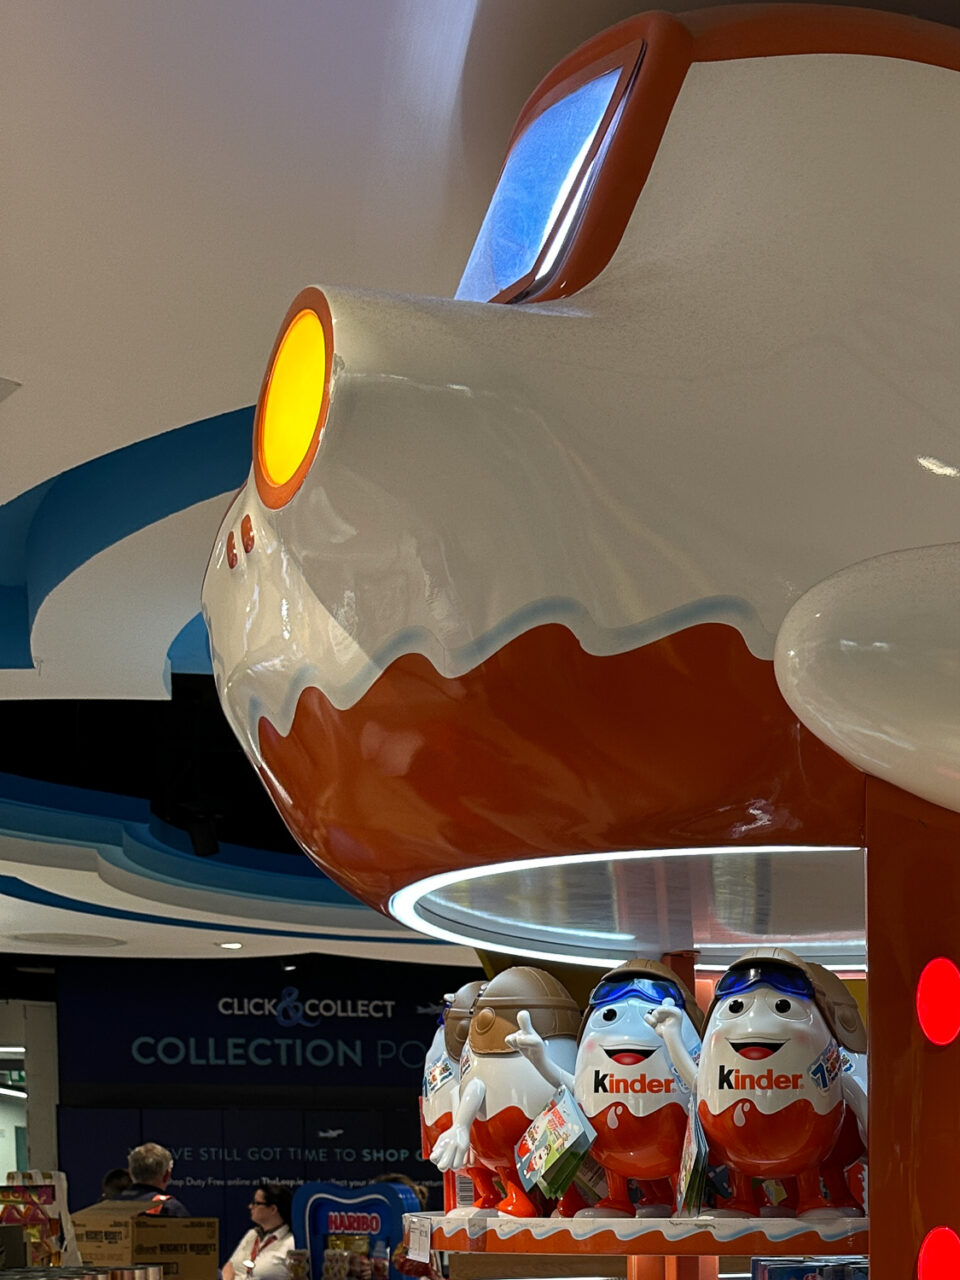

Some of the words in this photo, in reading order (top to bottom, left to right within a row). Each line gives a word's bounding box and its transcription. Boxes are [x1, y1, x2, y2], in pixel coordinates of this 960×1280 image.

[131, 1036, 362, 1067] COLLECTION
[200, 1148, 242, 1161] STILL
[247, 1148, 282, 1161] GOT
[289, 1148, 328, 1162] TIME
[335, 1149, 356, 1162] TO
[361, 1149, 408, 1162] SHOP
[185, 1177, 206, 1188] Duty
[208, 1177, 225, 1187] Free
[328, 1212, 381, 1235] HARIBO
